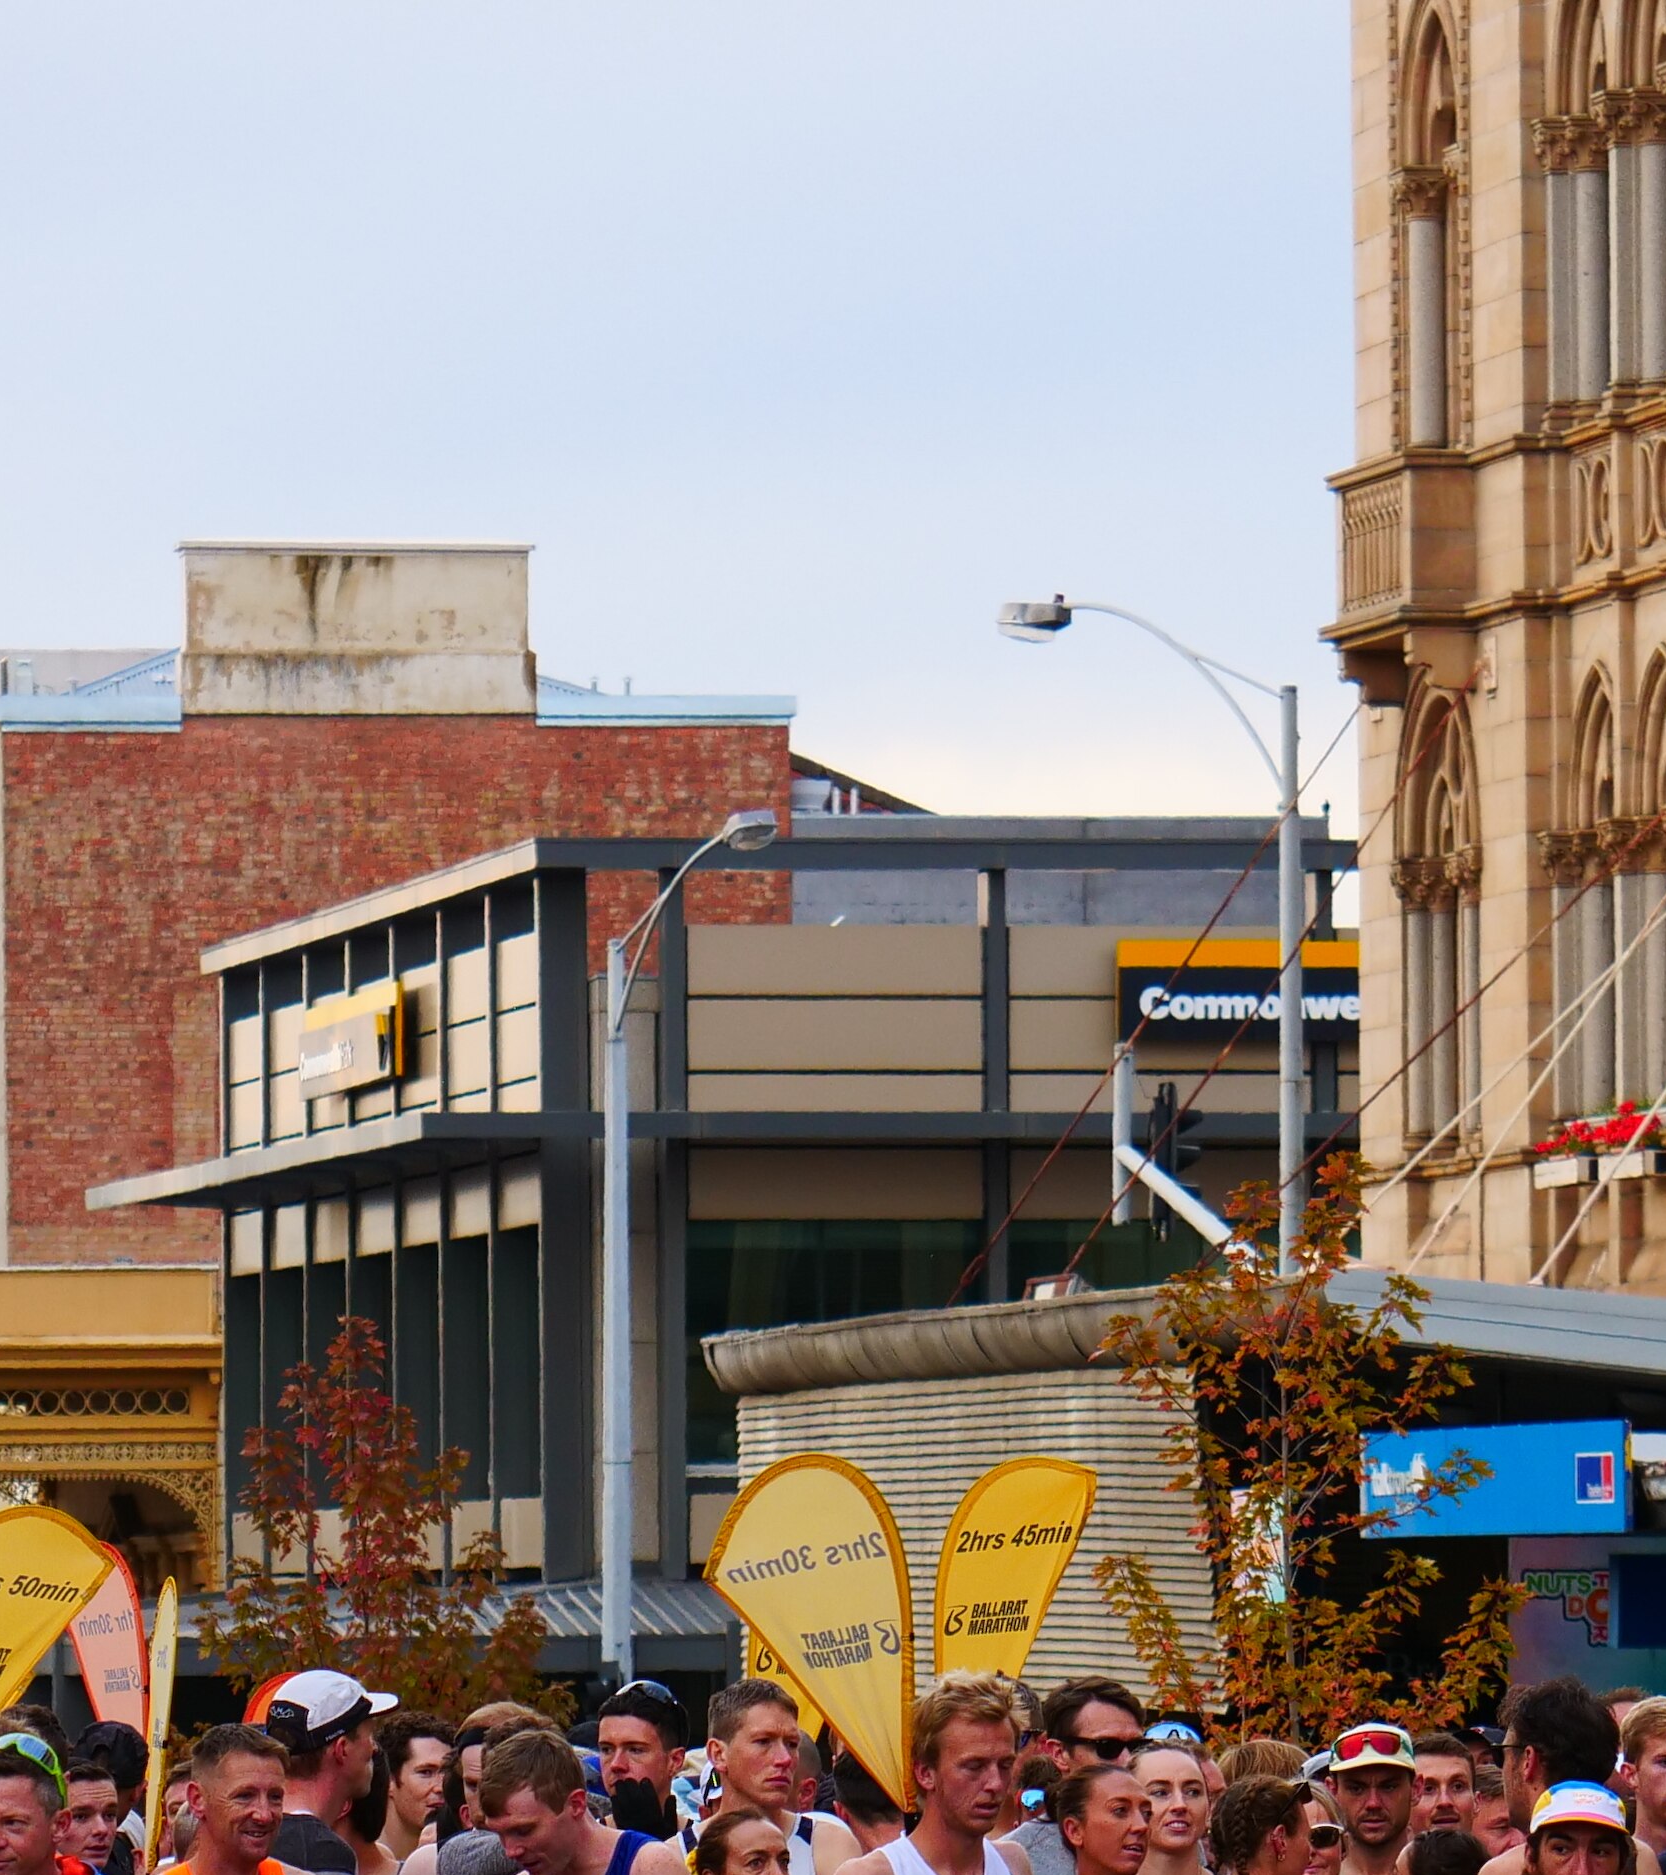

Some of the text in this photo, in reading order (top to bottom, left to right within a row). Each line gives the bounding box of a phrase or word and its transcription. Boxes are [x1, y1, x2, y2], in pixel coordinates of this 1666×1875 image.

[956, 1521, 1075, 1555] 2hrs 45min
[11, 1574, 81, 1604] 50min
[972, 1599, 1029, 1617] BALLARAT
[967, 1614, 1030, 1635] MARATHON
